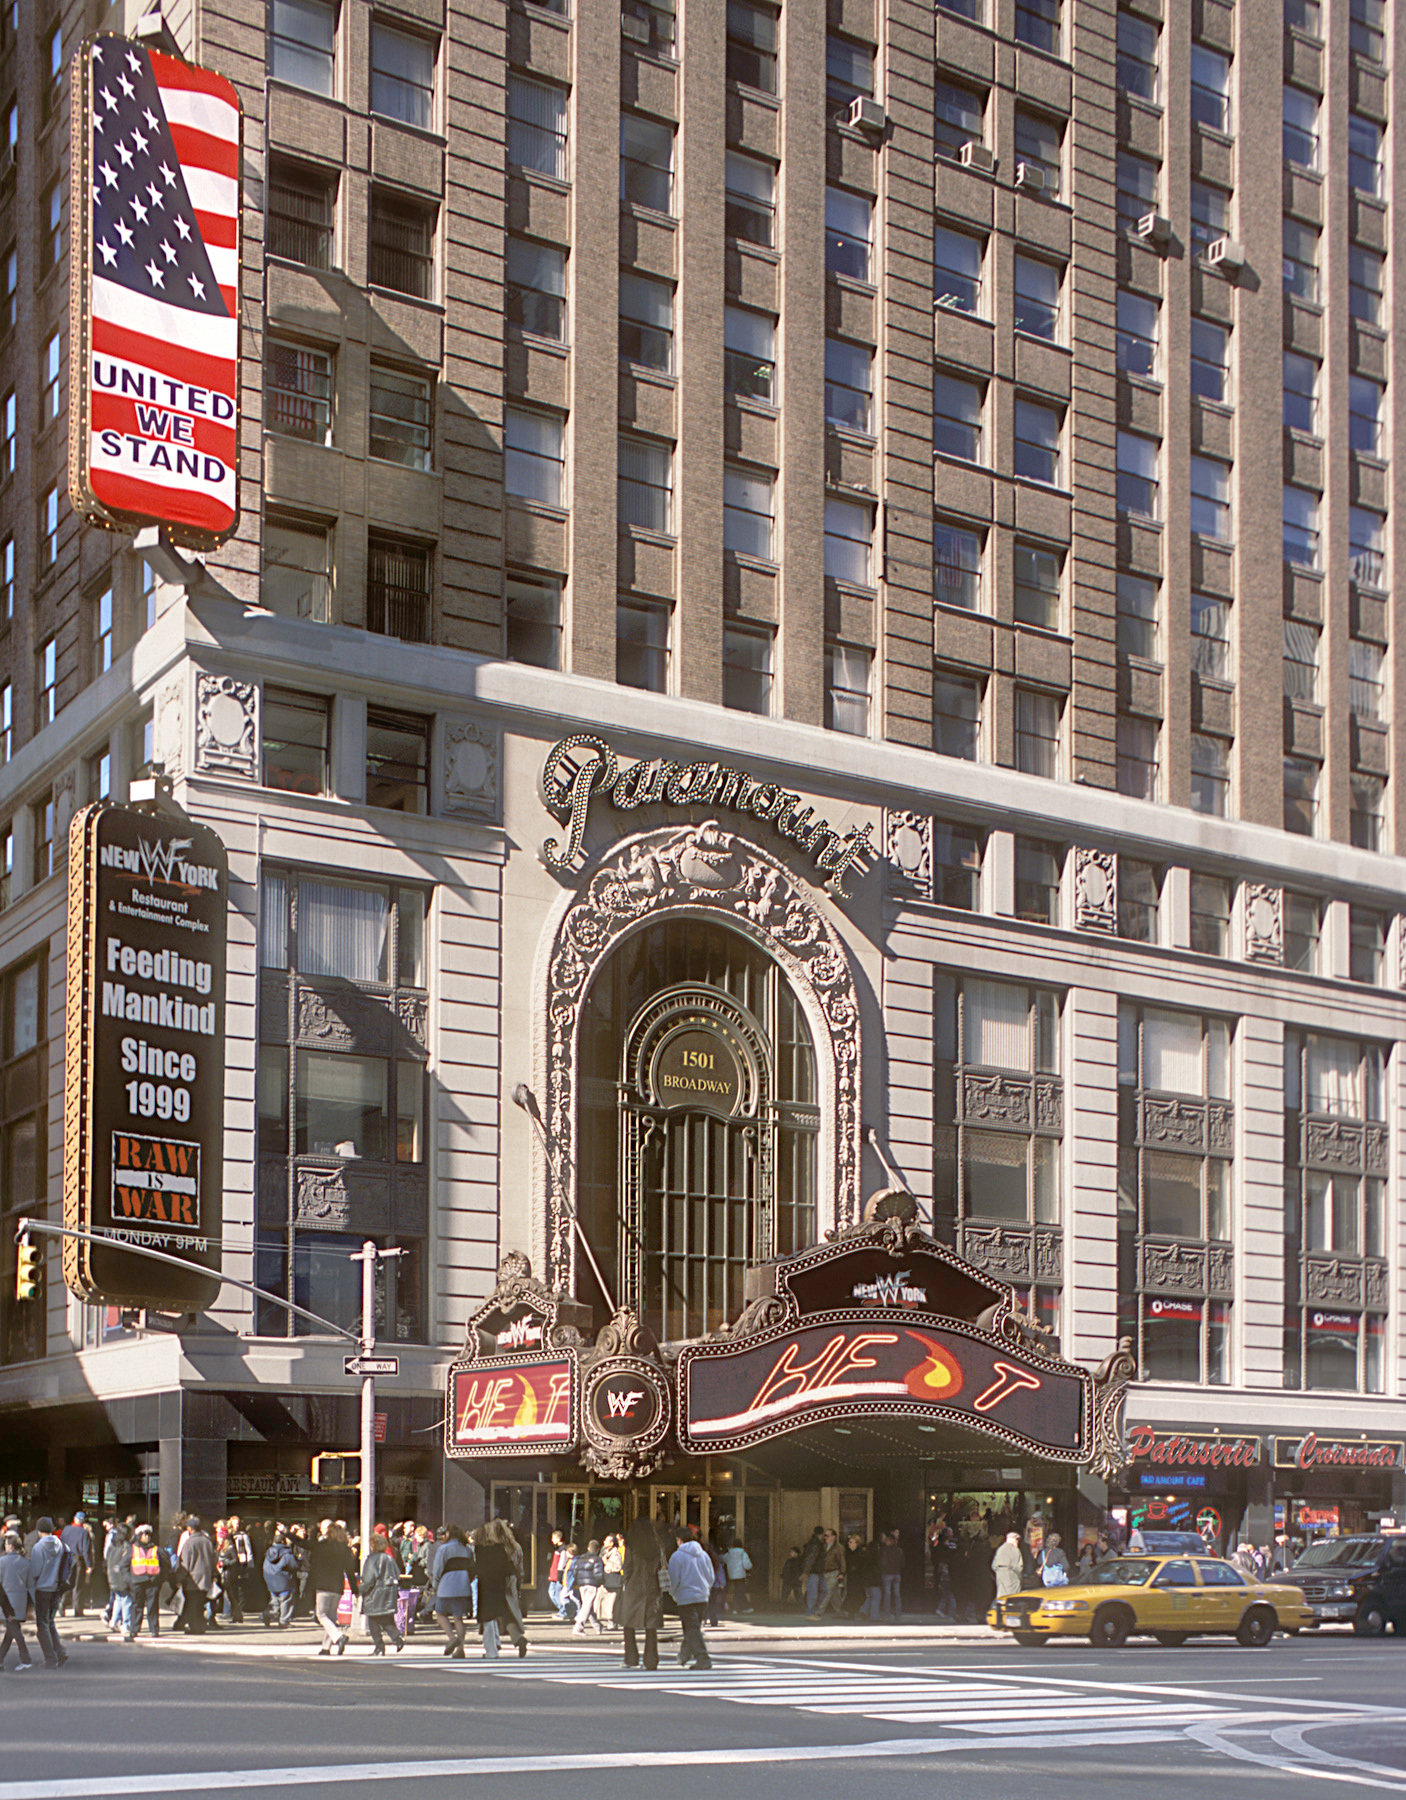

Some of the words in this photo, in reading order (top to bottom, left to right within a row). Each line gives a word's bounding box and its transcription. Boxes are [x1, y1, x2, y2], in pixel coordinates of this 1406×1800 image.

[93, 358, 234, 421] UNITED
[137, 404, 193, 443] WE
[100, 432, 227, 484] STAND
[541, 734, 875, 899] Paramount
[100, 844, 139, 873] NEW
[178, 860, 219, 891] YORK
[108, 900, 116, 912] &
[118, 902, 174, 926] Entertainment
[175, 915, 210, 933] Complex
[131, 888, 189, 914] Restaurant
[106, 936, 212, 995] Feeding
[102, 980, 216, 1036] Mankind
[120, 1036, 196, 1083] Since
[682, 1050, 714, 1070] 1501
[124, 1080, 191, 1123] 1999
[663, 1074, 732, 1095] BROADWAY
[118, 1137, 193, 1175] RAW
[147, 1174, 164, 1190] IS
[117, 1187, 194, 1224] WAR
[103, 1228, 171, 1248] MONDAY
[175, 1236, 208, 1253] 9PM
[853, 1283, 878, 1299] NEW
[901, 1286, 927, 1303] YORK
[1162, 1300, 1193, 1312] CHASE
[351, 1362, 366, 1370] ONE
[376, 1362, 392, 1370] WAY
[1128, 1426, 1255, 1468] Patisserie
[1298, 1433, 1396, 1469] Croissants
[226, 1478, 300, 1492] RESTAURANT
[1140, 1475, 1184, 1485] PARAMOUNT
[1186, 1476, 1205, 1486] CAFE
